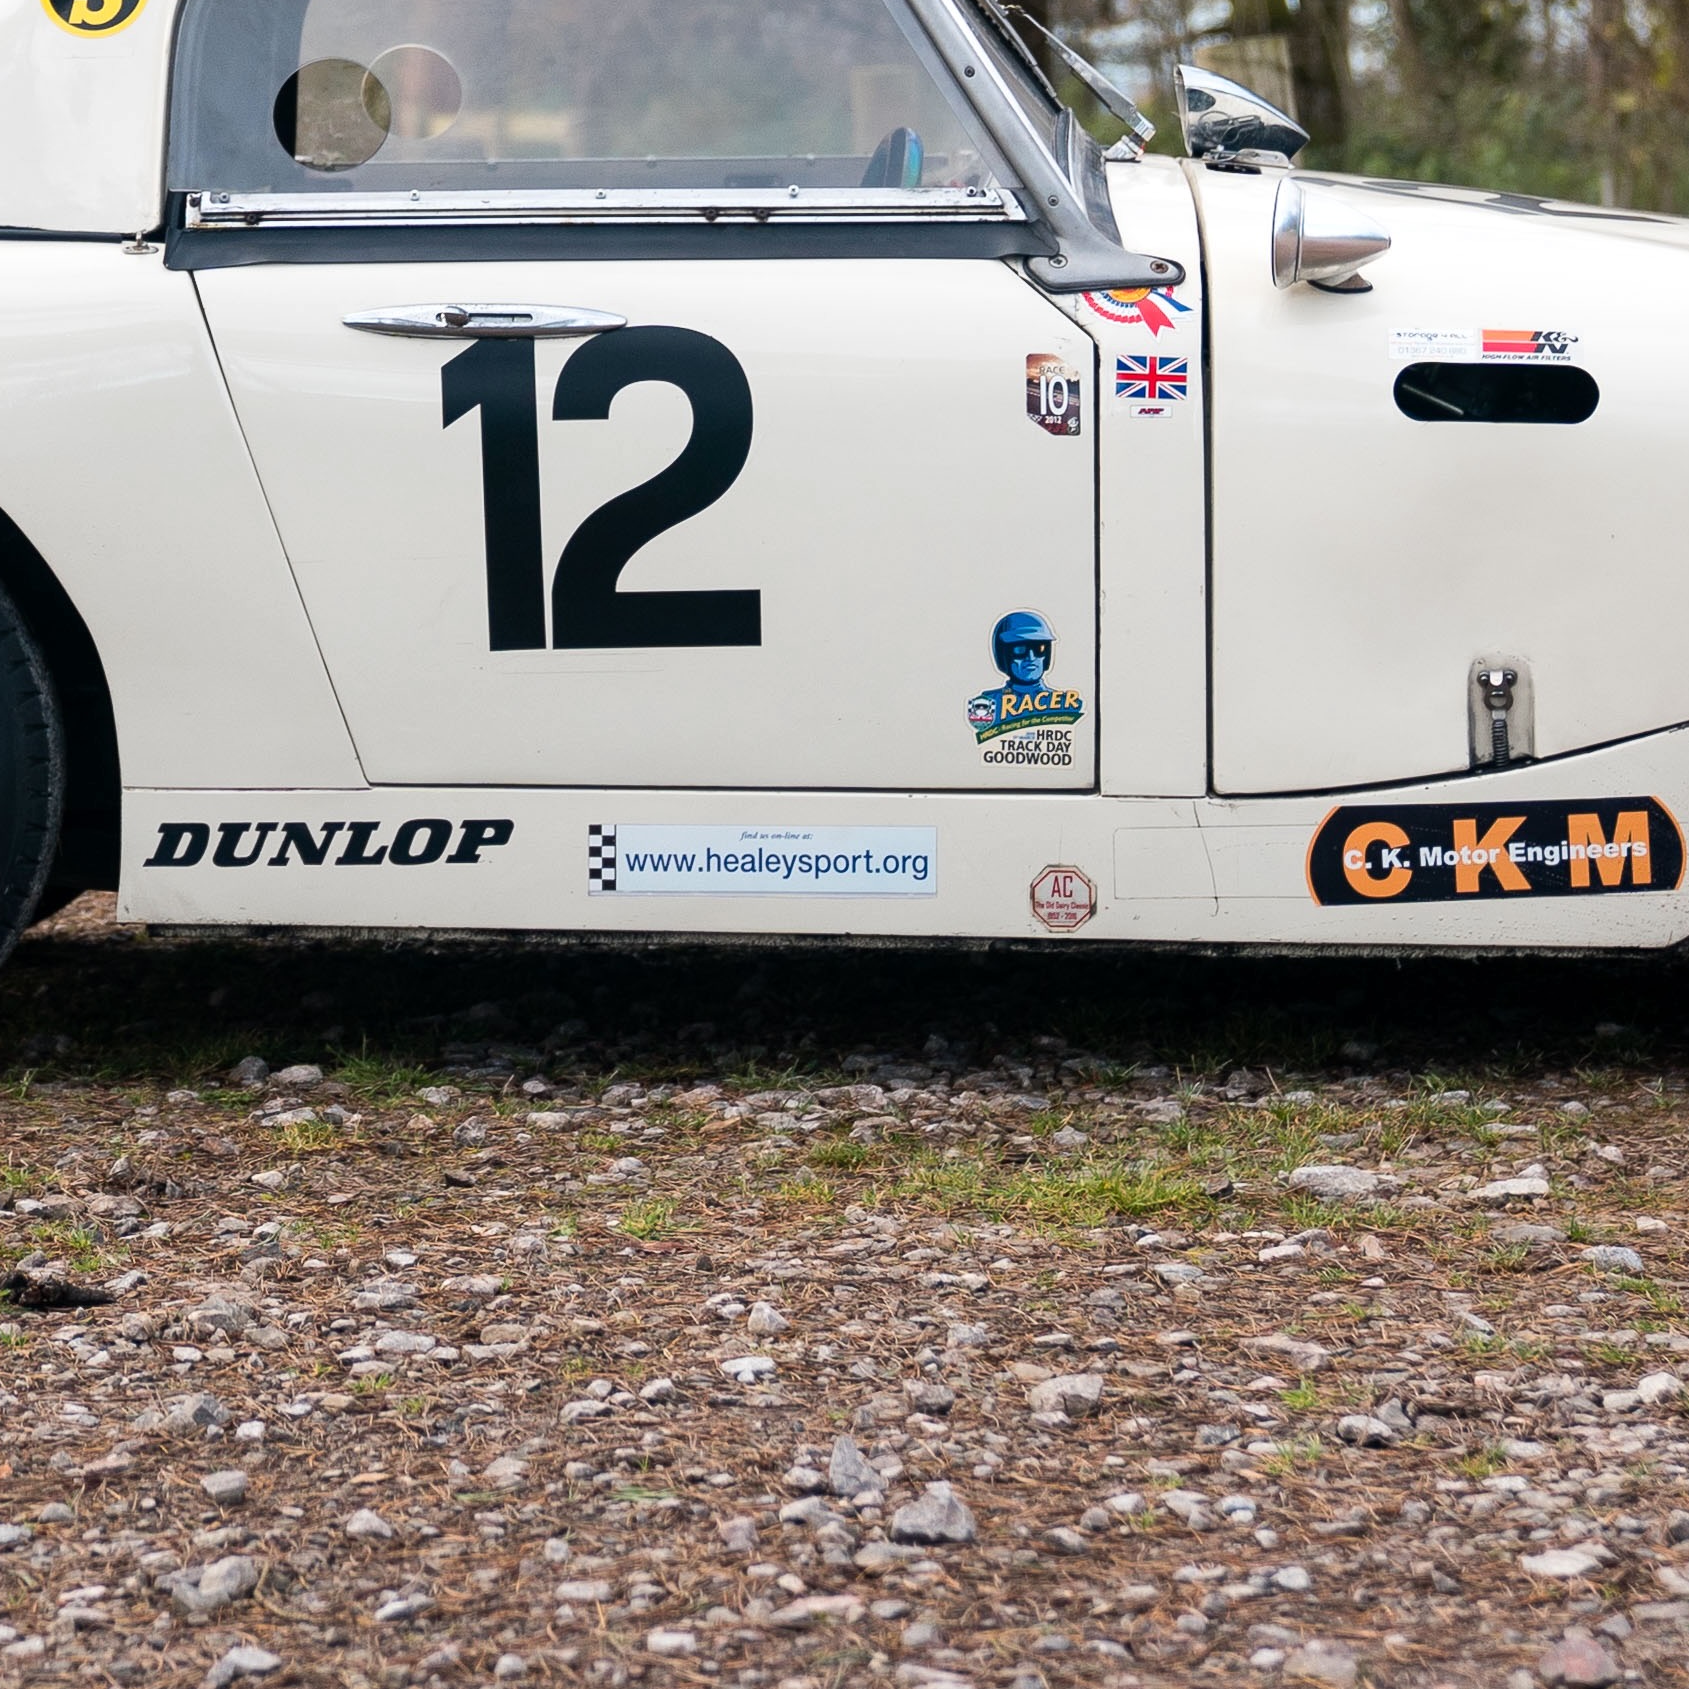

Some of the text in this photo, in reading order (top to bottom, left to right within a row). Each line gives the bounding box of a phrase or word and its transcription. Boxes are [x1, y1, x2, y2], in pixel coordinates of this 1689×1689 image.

[1039, 366, 1065, 375] RACE
[1040, 375, 1068, 416] 10
[441, 324, 763, 652] 12
[1000, 690, 1080, 720] RACER
[1000, 740, 1072, 753] TRACK DAY
[1037, 729, 1072, 742] HRDC
[983, 751, 1072, 765] GOODWOOD
[143, 818, 515, 868] DUNLOP
[739, 832, 758, 841] find
[626, 847, 929, 880] www.healeysport.org
[1381, 848, 1410, 869] K.
[1419, 844, 1501, 868] Motor
[1509, 840, 1648, 866] Engineers
[1051, 875, 1073, 898] AC
